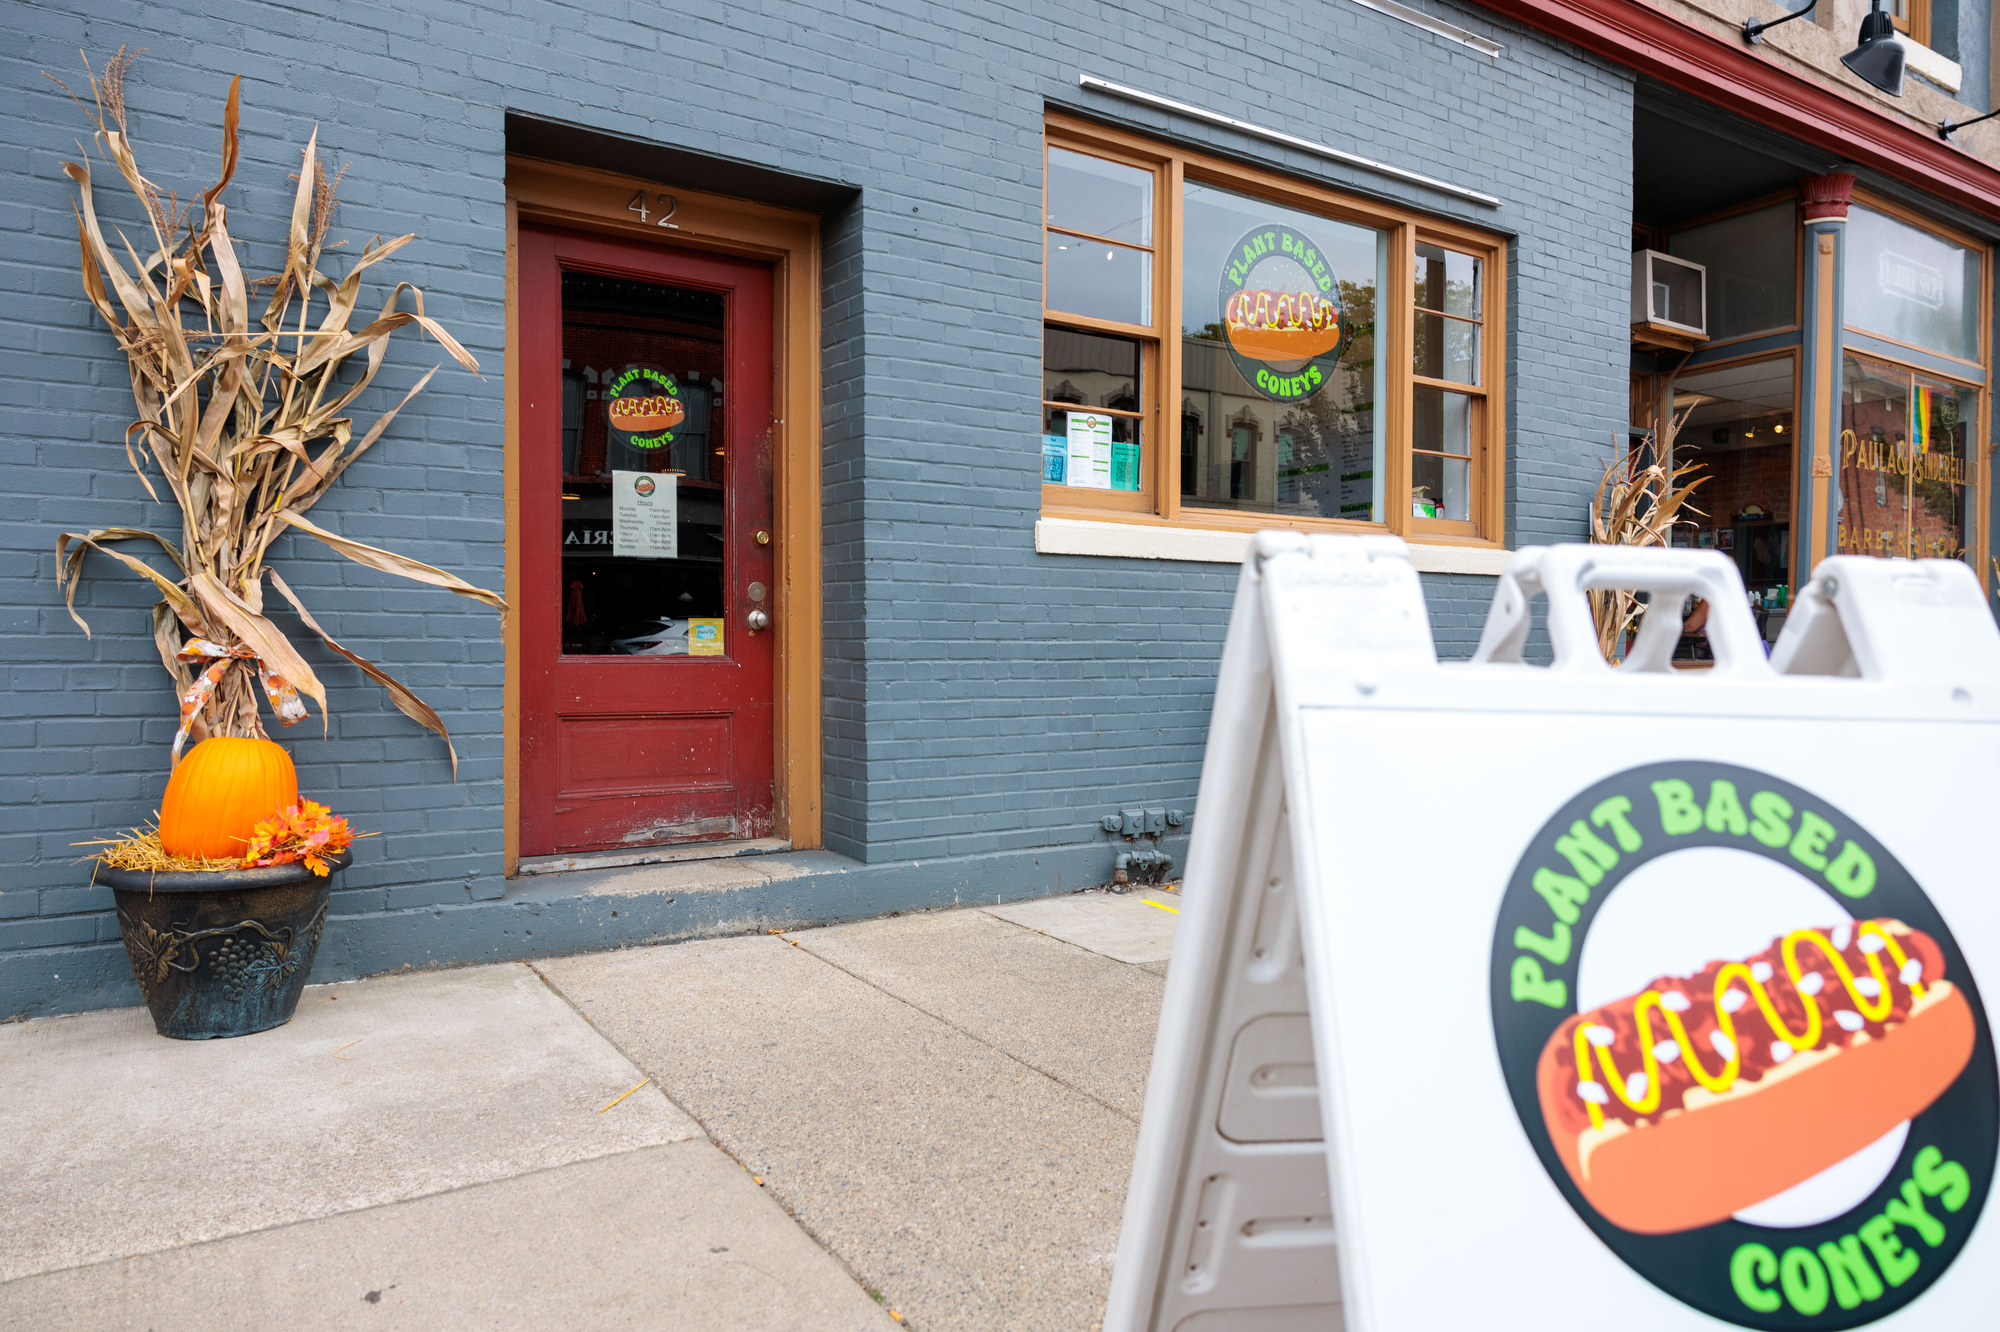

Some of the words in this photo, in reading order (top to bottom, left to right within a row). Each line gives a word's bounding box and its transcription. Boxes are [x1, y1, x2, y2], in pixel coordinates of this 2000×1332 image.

[628, 189, 679, 230] 42
[1228, 231, 1276, 287] PLANT
[1281, 232, 1332, 292] BASED
[609, 369, 640, 398] PLANT
[643, 368, 678, 396] BASED
[1256, 365, 1322, 397] CONEYS
[630, 431, 674, 449] CONEYS
[1840, 428, 1898, 475] PAULA
[1838, 524, 1907, 551] BARBER
[1914, 533, 1959, 558] SHOP
[1510, 794, 1643, 1009] PLANT
[1650, 778, 1877, 899] BASED
[1729, 1144, 1971, 1317] CONEYS
